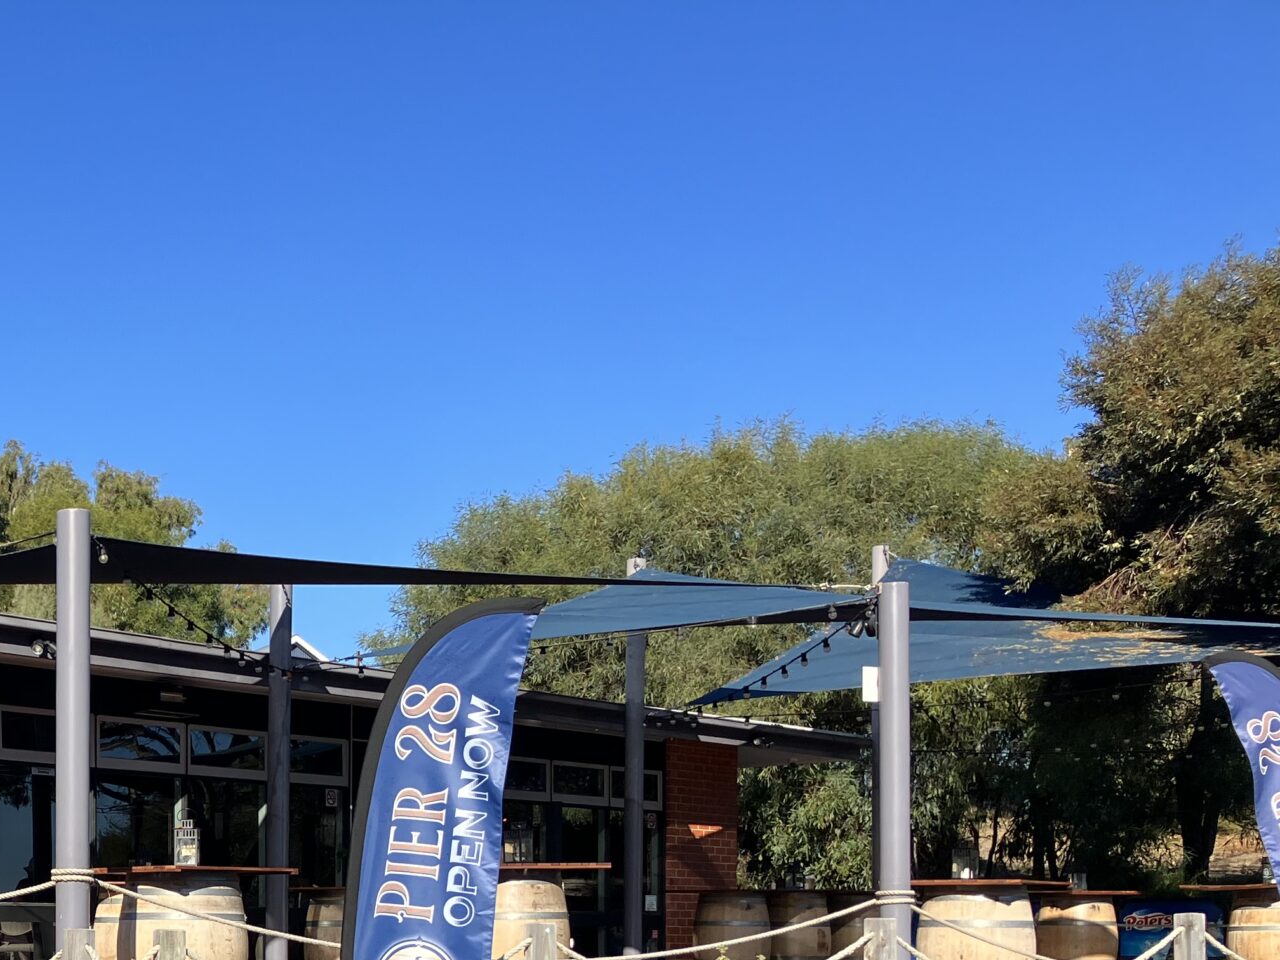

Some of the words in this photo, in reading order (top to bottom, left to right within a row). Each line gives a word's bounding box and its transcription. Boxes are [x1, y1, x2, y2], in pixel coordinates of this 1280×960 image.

[394, 682, 461, 764] 28
[457, 694, 501, 801] NOW
[373, 787, 449, 924] PIER
[443, 808, 488, 928] OPEN
